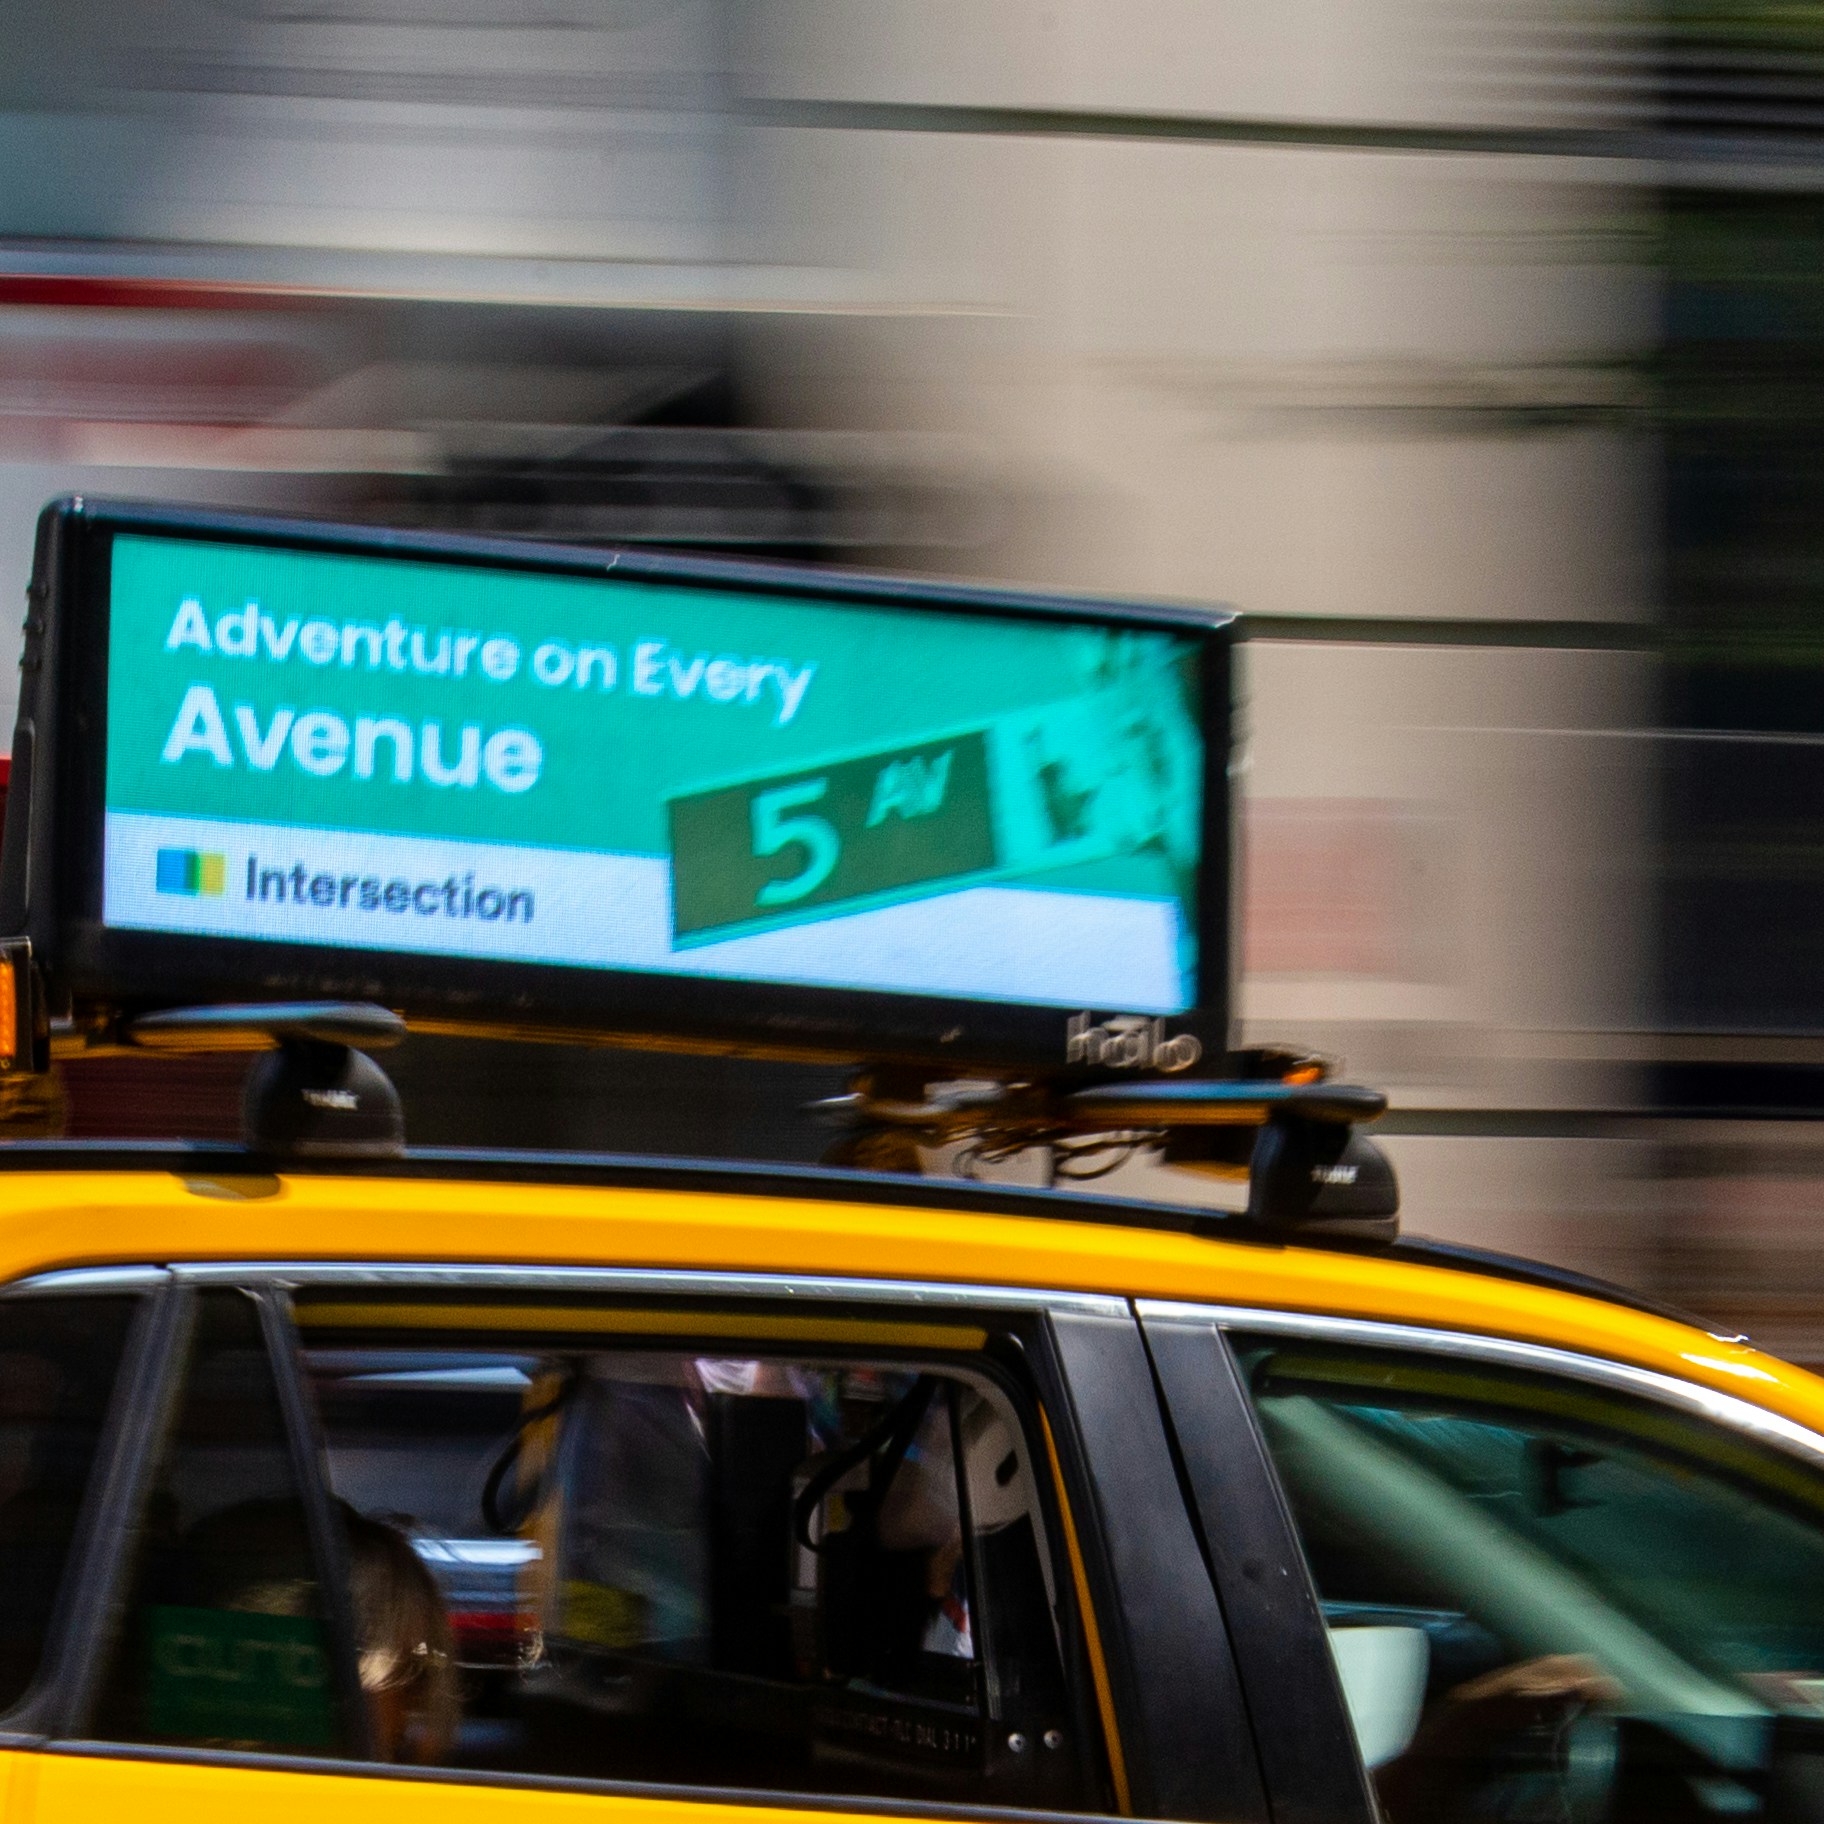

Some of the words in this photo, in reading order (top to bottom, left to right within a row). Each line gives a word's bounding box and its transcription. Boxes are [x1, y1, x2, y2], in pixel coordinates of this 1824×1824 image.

[164, 594, 522, 682] Adventure
[532, 637, 620, 692] on
[631, 637, 814, 729] Every
[159, 683, 544, 795] Avenue
[246, 855, 537, 925] Intersection
[750, 777, 843, 909] 5
